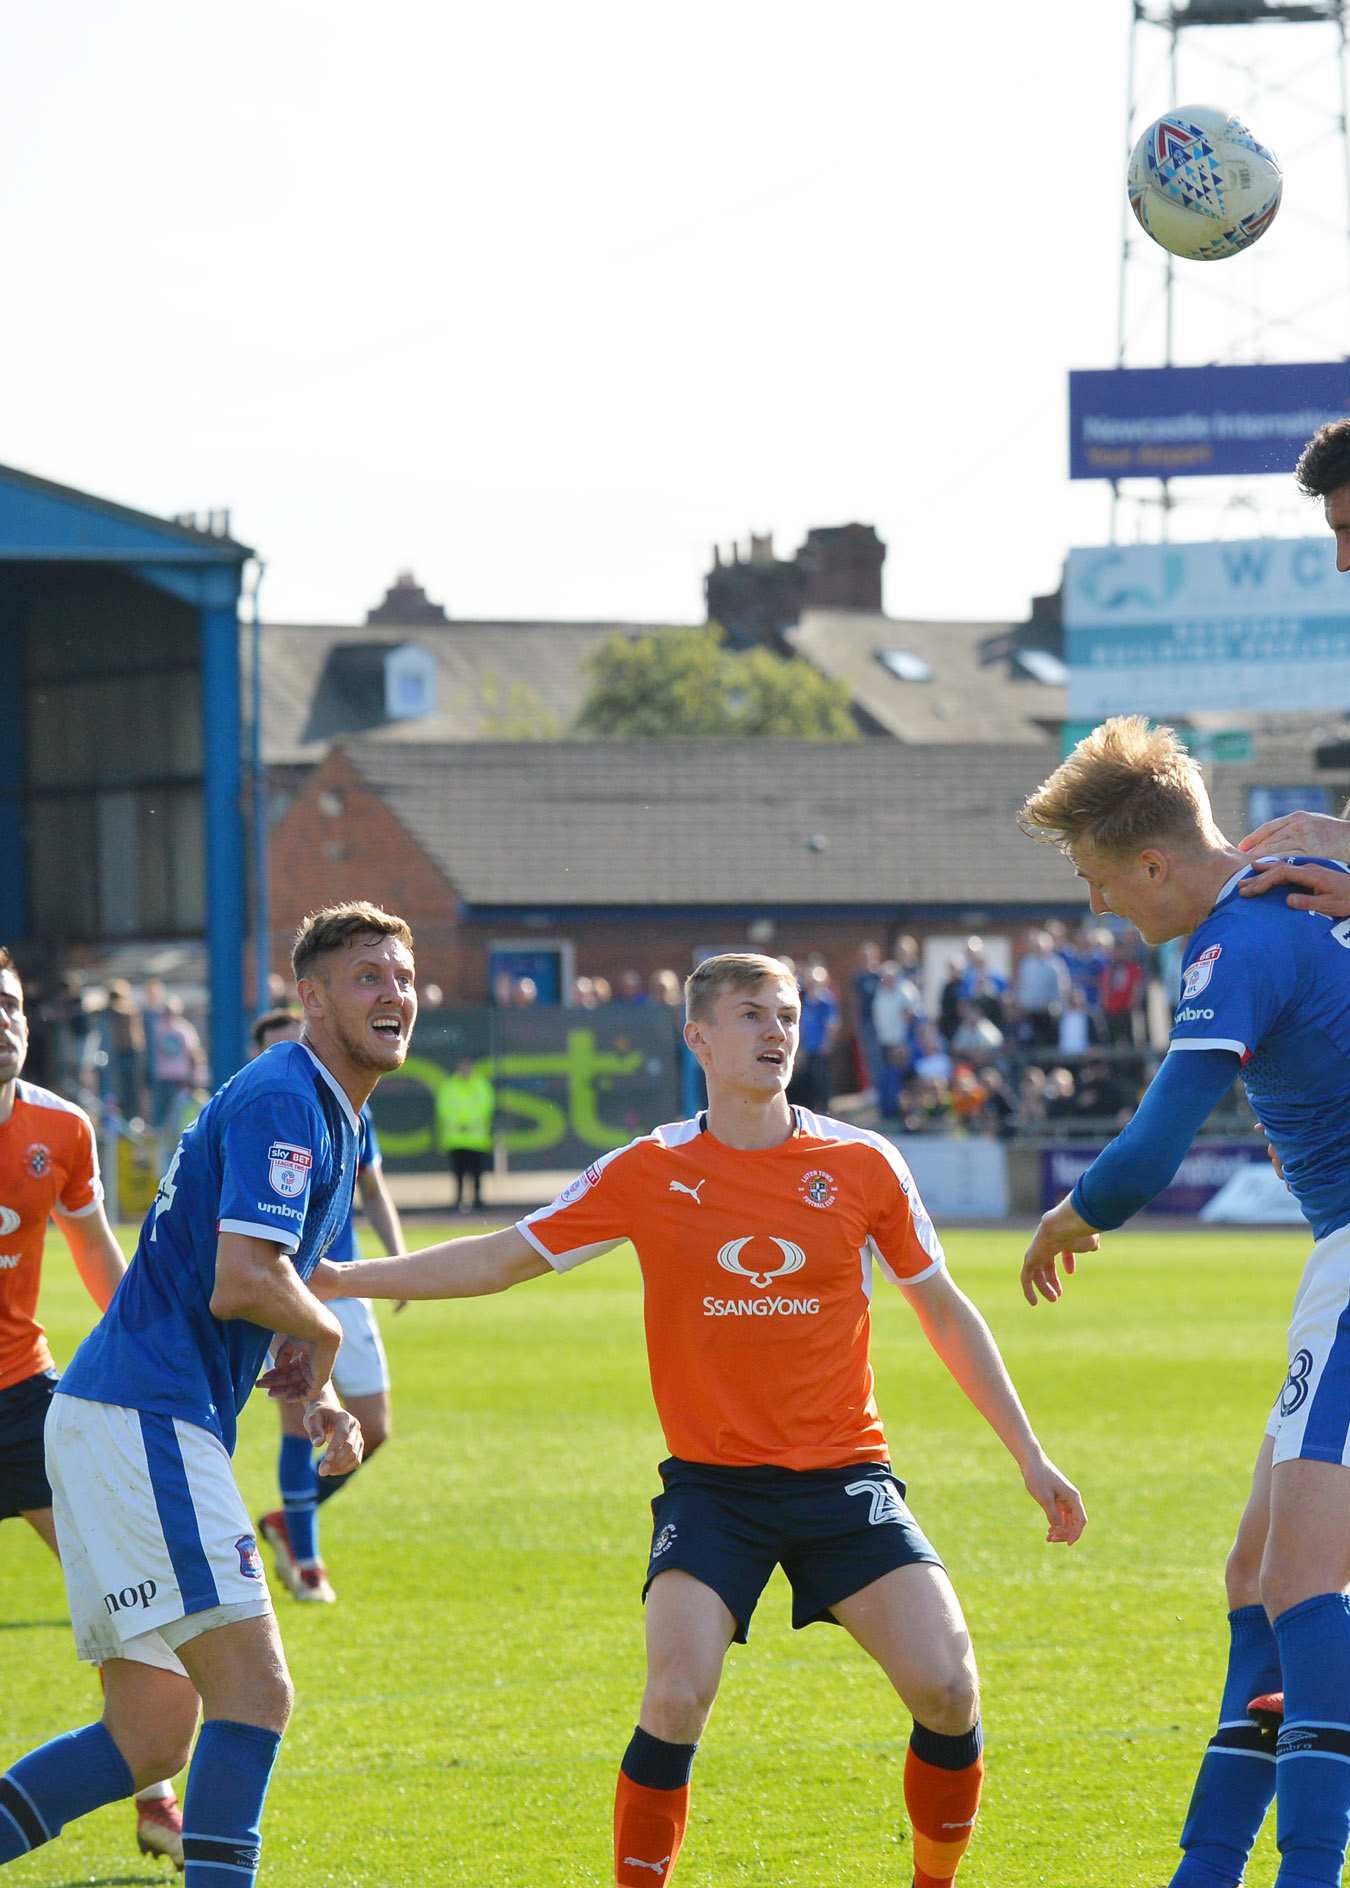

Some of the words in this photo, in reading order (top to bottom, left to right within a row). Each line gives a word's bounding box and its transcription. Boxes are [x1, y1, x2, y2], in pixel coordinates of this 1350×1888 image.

[275, 1160, 293, 1168] LEAGUE
[293, 1153, 310, 1165] BET
[801, 1170, 818, 1183] LUTON
[819, 1170, 834, 1183] TOWN
[281, 1184, 292, 1192] EFL
[257, 1202, 304, 1221] umbro
